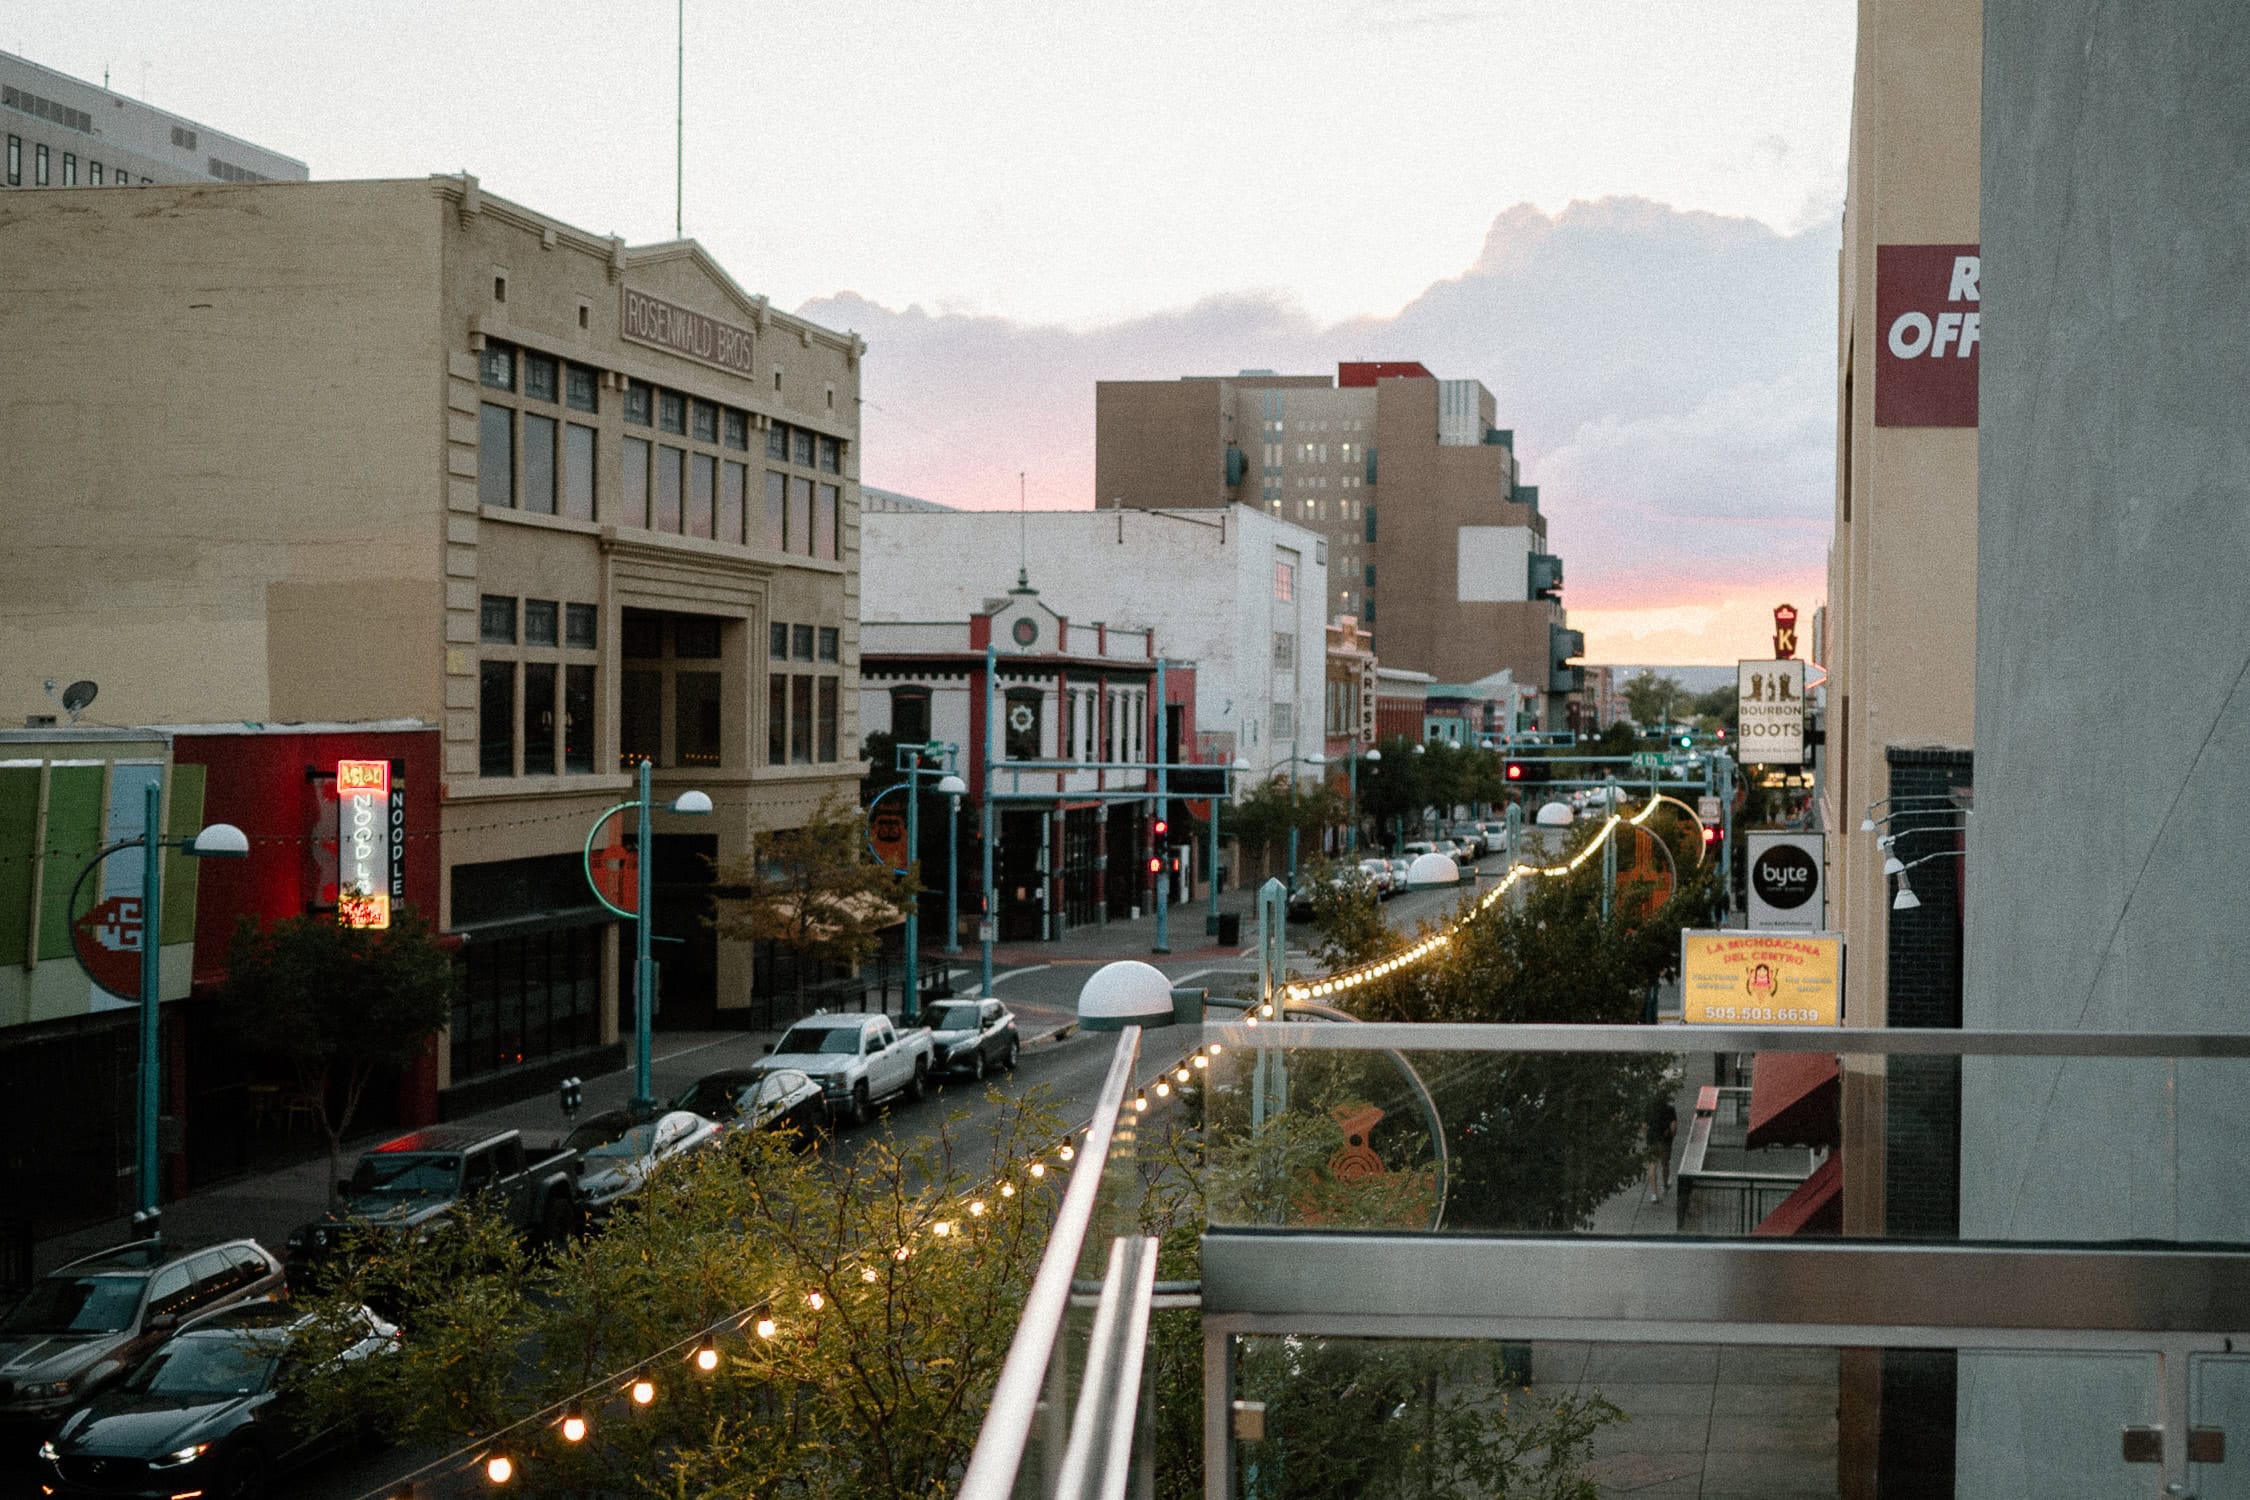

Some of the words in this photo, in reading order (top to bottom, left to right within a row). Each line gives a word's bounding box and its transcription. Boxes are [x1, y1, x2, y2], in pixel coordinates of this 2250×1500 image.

[628, 293, 712, 357] ROSENWALD
[717, 325, 751, 370] BROS
[1780, 629, 1793, 650] K
[1363, 660, 1373, 741] KRESS
[1740, 706, 1802, 716] BOURBON
[1740, 723, 1802, 737] BOOTS
[1634, 752, 1659, 766] 4th
[391, 792, 404, 895] NOODLE
[1762, 862, 1808, 887] byte
[1706, 944, 1724, 955] LA
[1728, 938, 1820, 956] MICHOACANA
[1723, 952, 1747, 964] DEL
[1751, 952, 1804, 965] CENTRO
[1705, 1006, 1819, 1021] 505.503.6639
